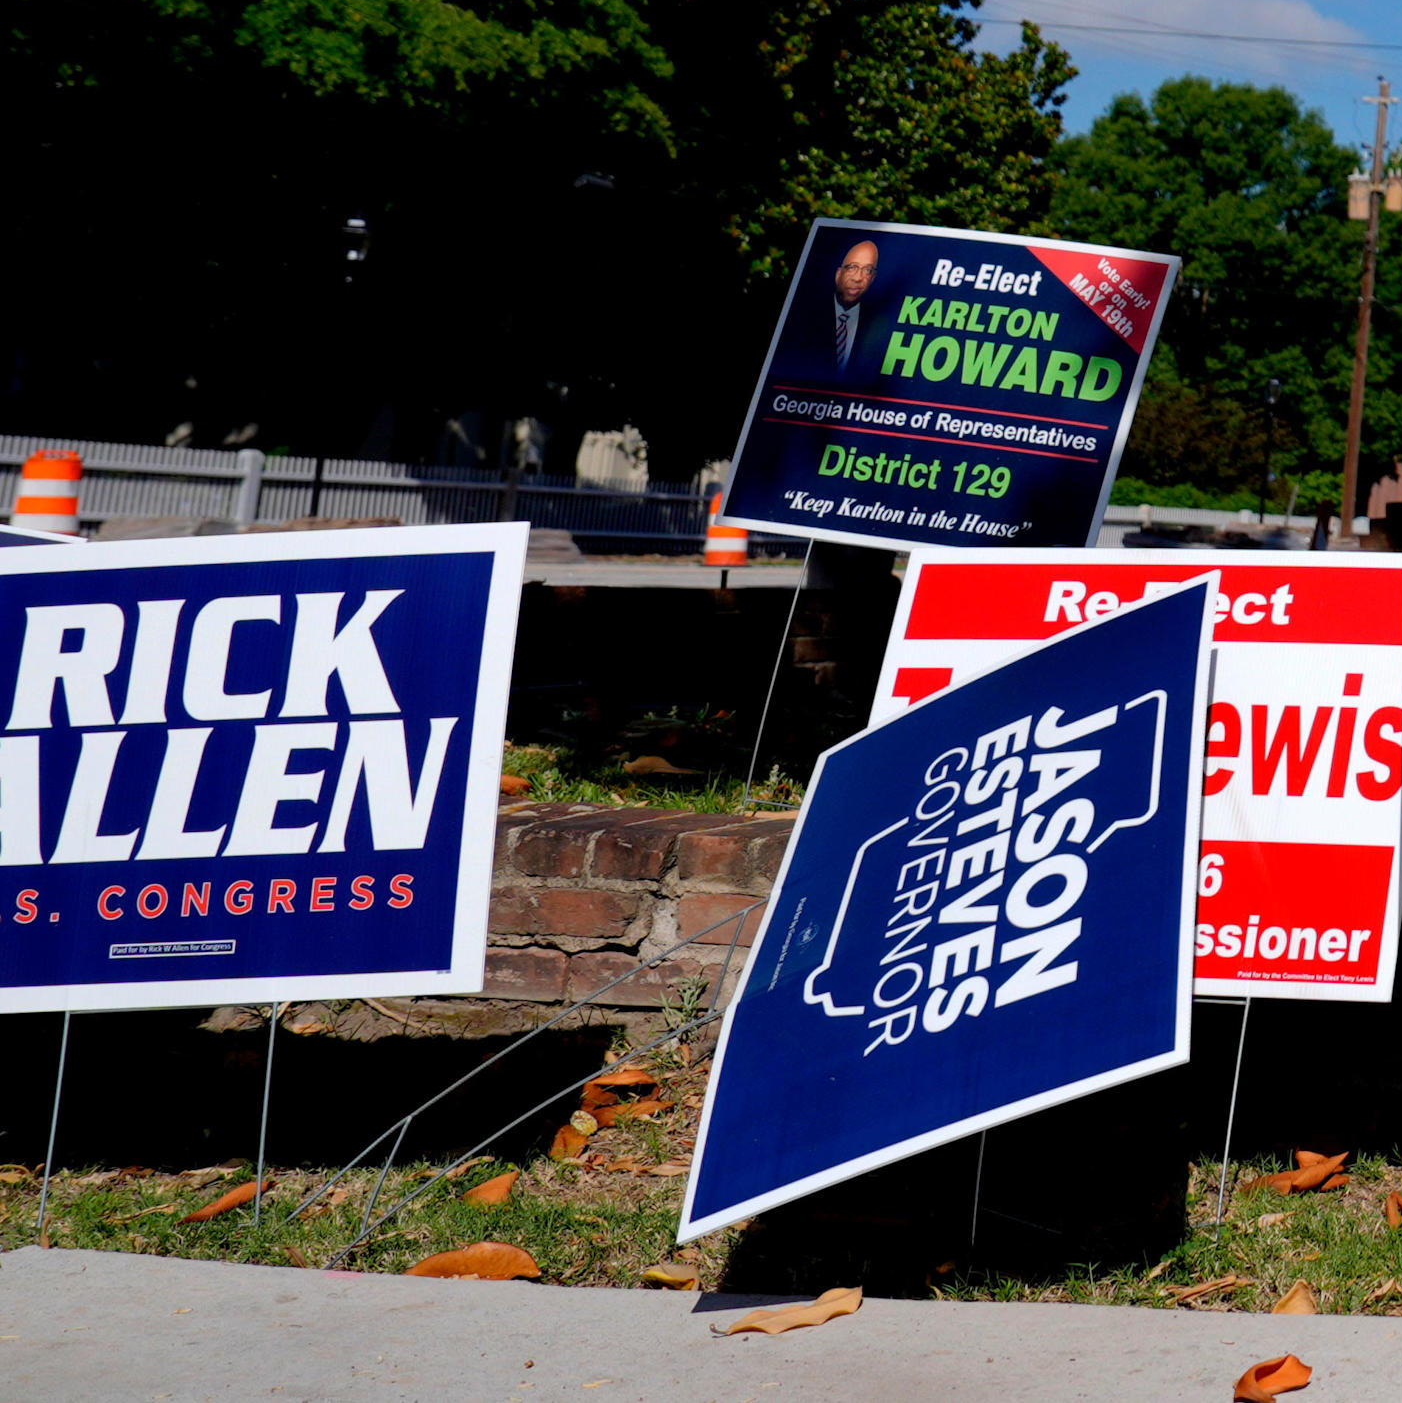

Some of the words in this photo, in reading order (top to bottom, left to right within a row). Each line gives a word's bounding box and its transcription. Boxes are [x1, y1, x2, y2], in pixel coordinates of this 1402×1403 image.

[931, 259, 1042, 296] Re-Elect
[1097, 257, 1121, 283] Vote
[1119, 279, 1151, 310] Early!
[1098, 281, 1114, 294] or
[1111, 294, 1128, 310] on
[897, 295, 1059, 342] KARLTON
[1069, 272, 1105, 306] MAY
[1101, 304, 1134, 338] 19th
[880, 331, 1124, 403] HOWARD
[773, 394, 842, 422] Georgia
[847, 403, 906, 428] House
[910, 411, 932, 431] of
[935, 412, 1097, 452] Representatives
[818, 444, 940, 490] District
[953, 461, 1012, 499] 129
[784, 490, 834, 518] “Keep
[837, 497, 905, 524] Karlton
[907, 507, 925, 525] in
[928, 510, 958, 530] the
[958, 513, 1033, 538] House”
[1043, 581, 1294, 625] Re-ect
[4, 589, 406, 730] RICK
[922, 715, 1032, 1032] ESTEVES
[994, 705, 1118, 1008] JASON
[98, 873, 414, 920] CONGRESS
[863, 746, 969, 1057] GOVERNOR
[201, 943, 231, 951] Congress
[1194, 915, 1372, 962] ssioner
[1282, 972, 1315, 980] Committee
